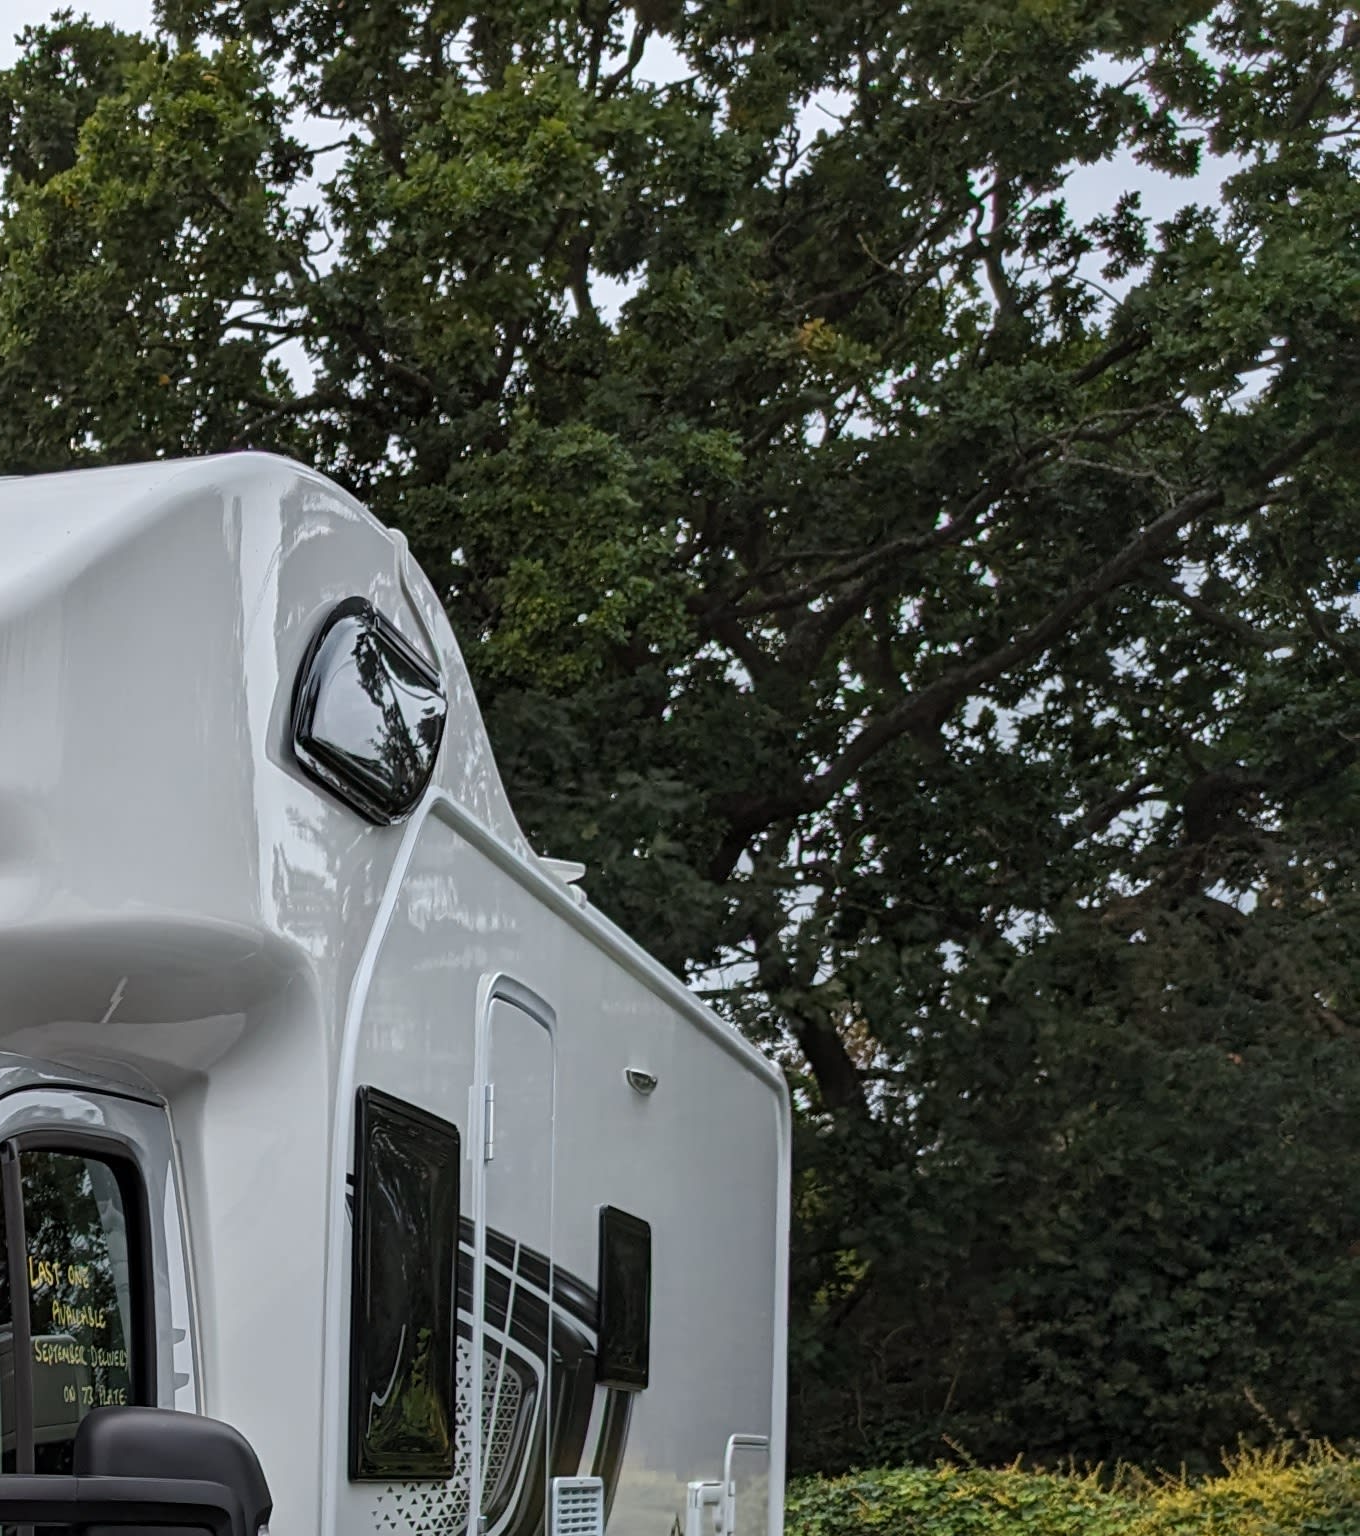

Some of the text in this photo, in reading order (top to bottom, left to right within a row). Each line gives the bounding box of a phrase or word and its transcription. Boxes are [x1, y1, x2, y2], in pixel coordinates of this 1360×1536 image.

[29, 1256, 89, 1288] LAST ONE
[52, 1300, 106, 1328] AVAILABLE
[34, 1338, 128, 1371] SEPTEMBER DELIVERY
[63, 1385, 76, 1403] ON
[82, 1386, 94, 1405] 73
